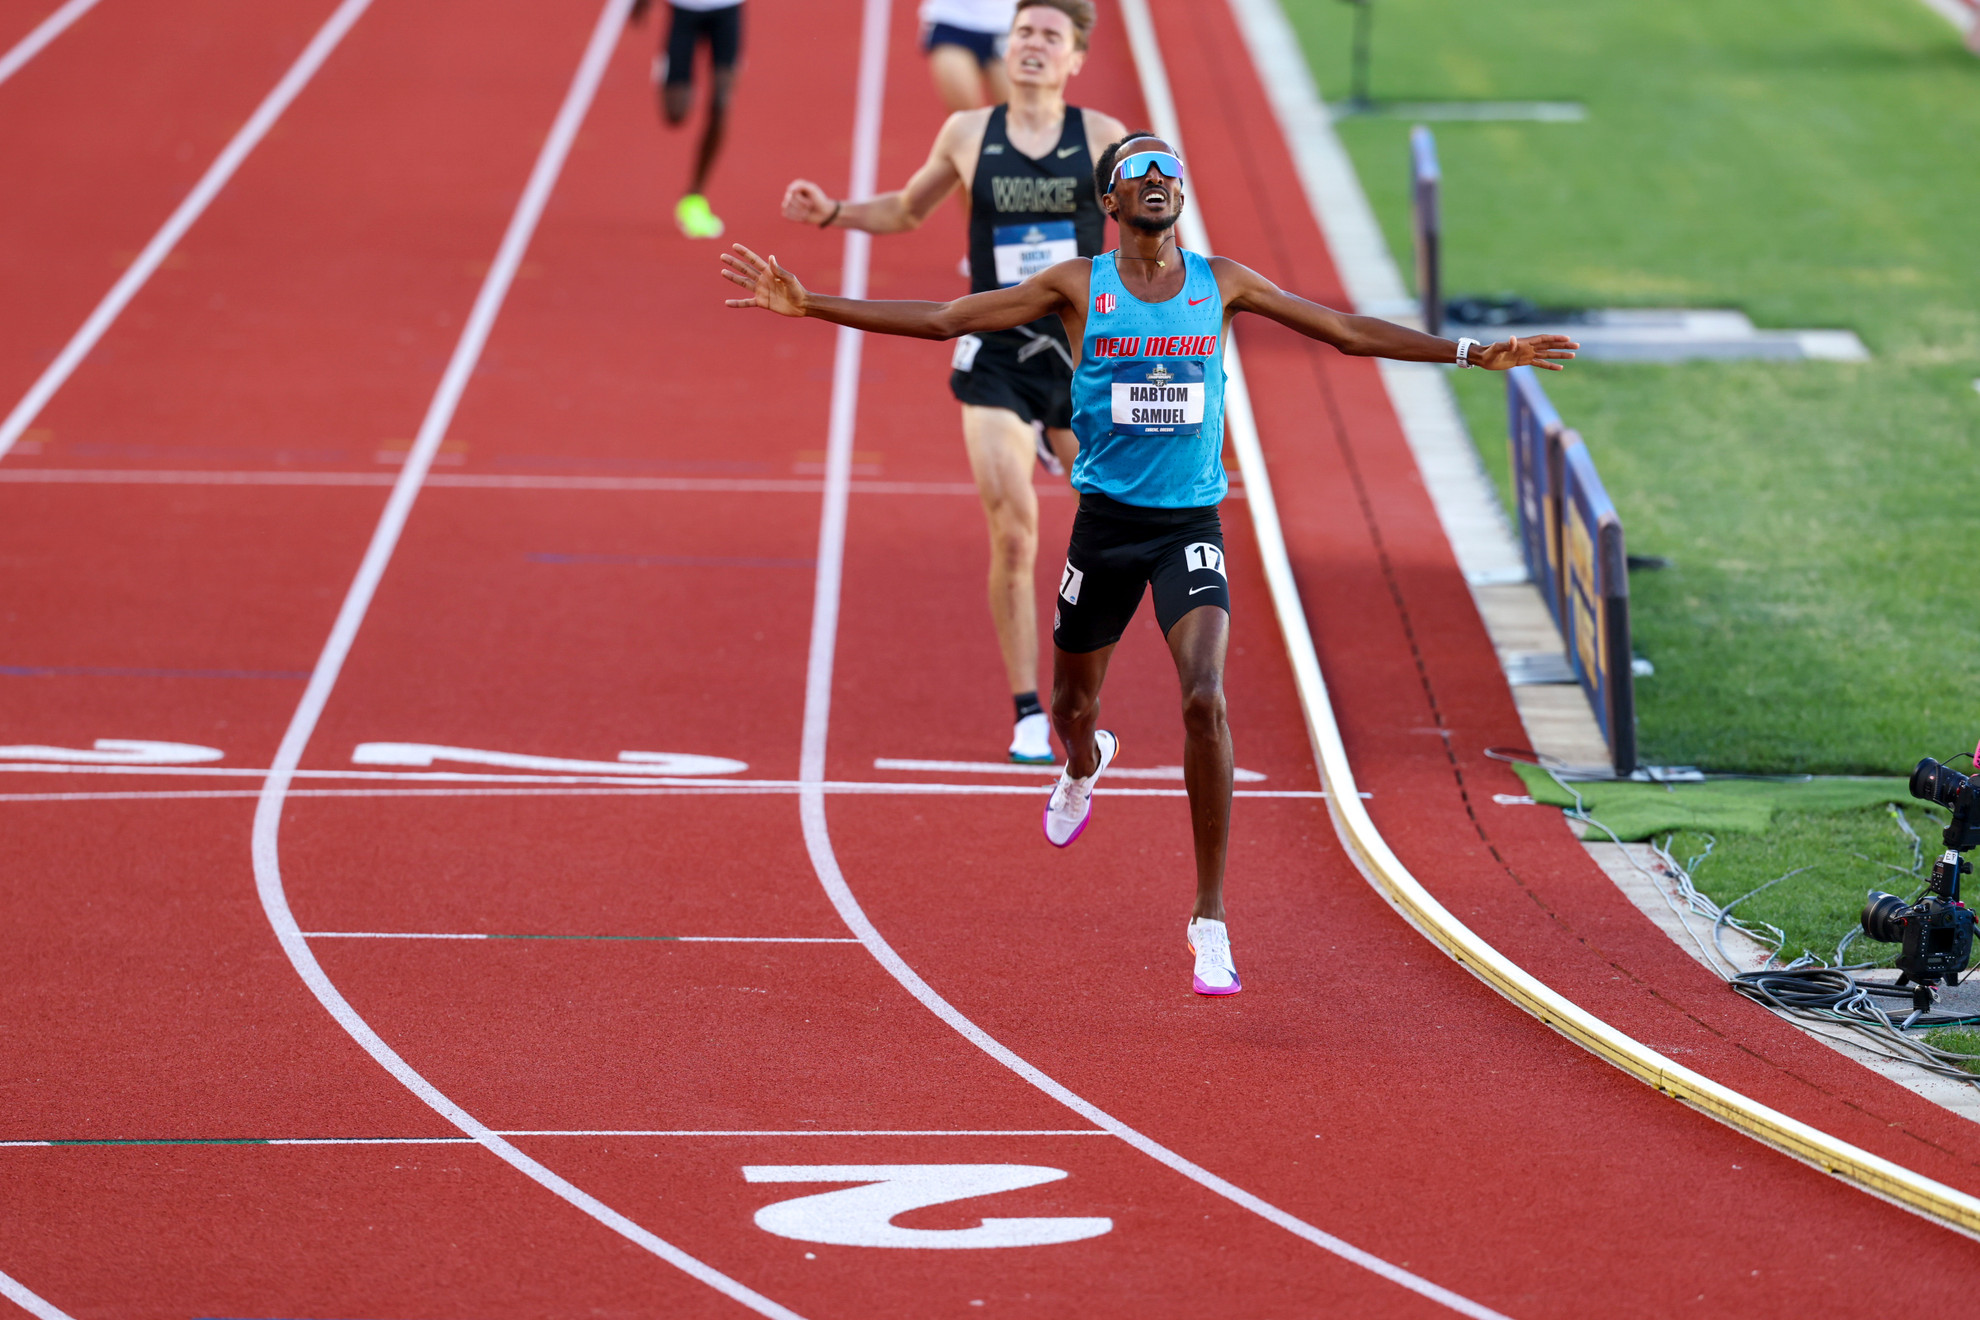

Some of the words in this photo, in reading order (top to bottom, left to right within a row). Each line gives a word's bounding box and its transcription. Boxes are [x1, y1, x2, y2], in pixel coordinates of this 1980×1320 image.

[992, 176, 1077, 212] WAKE
[1095, 337, 1141, 357] NEW
[1144, 335, 1217, 357] MEXICO
[1130, 387, 1188, 402] HABTOM
[1132, 408, 1185, 423] SAMUEL
[1193, 545, 1221, 570] 17
[1060, 565, 1075, 595] 7
[352, 742, 748, 776] 2
[743, 1164, 1113, 1249] 2
